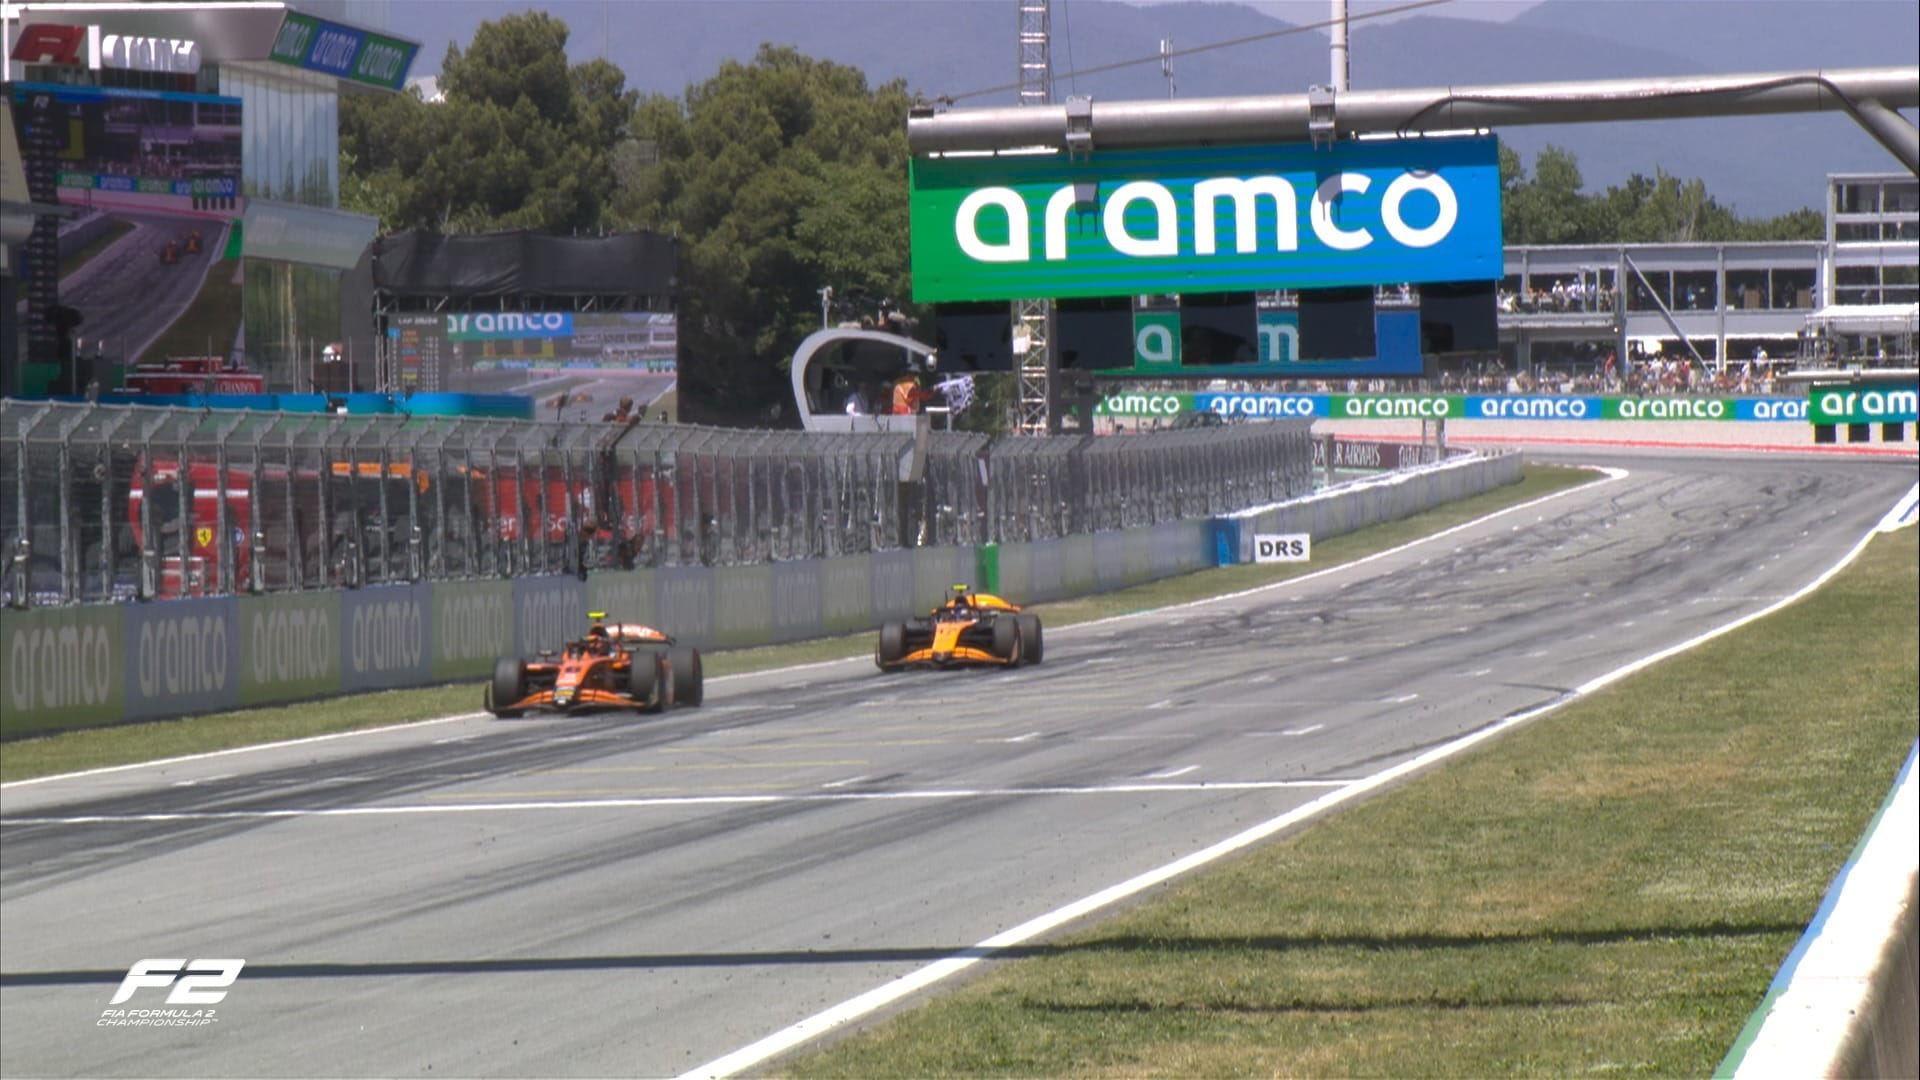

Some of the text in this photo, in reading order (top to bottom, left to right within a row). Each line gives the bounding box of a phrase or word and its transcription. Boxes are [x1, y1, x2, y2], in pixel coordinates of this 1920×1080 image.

[955, 172, 1457, 262] aramco
[1210, 396, 1314, 416] aramco
[1345, 396, 1449, 415] aramco
[1481, 397, 1586, 418] aramco
[1619, 398, 1724, 419] aramco
[1821, 392, 1917, 416] aram
[1345, 443, 1380, 466] AIRWAYS
[1259, 540, 1304, 557] DRS
[253, 607, 329, 684] aramco
[352, 600, 422, 673] aramco
[11, 624, 110, 711] aramco
[139, 615, 228, 697] aramco
